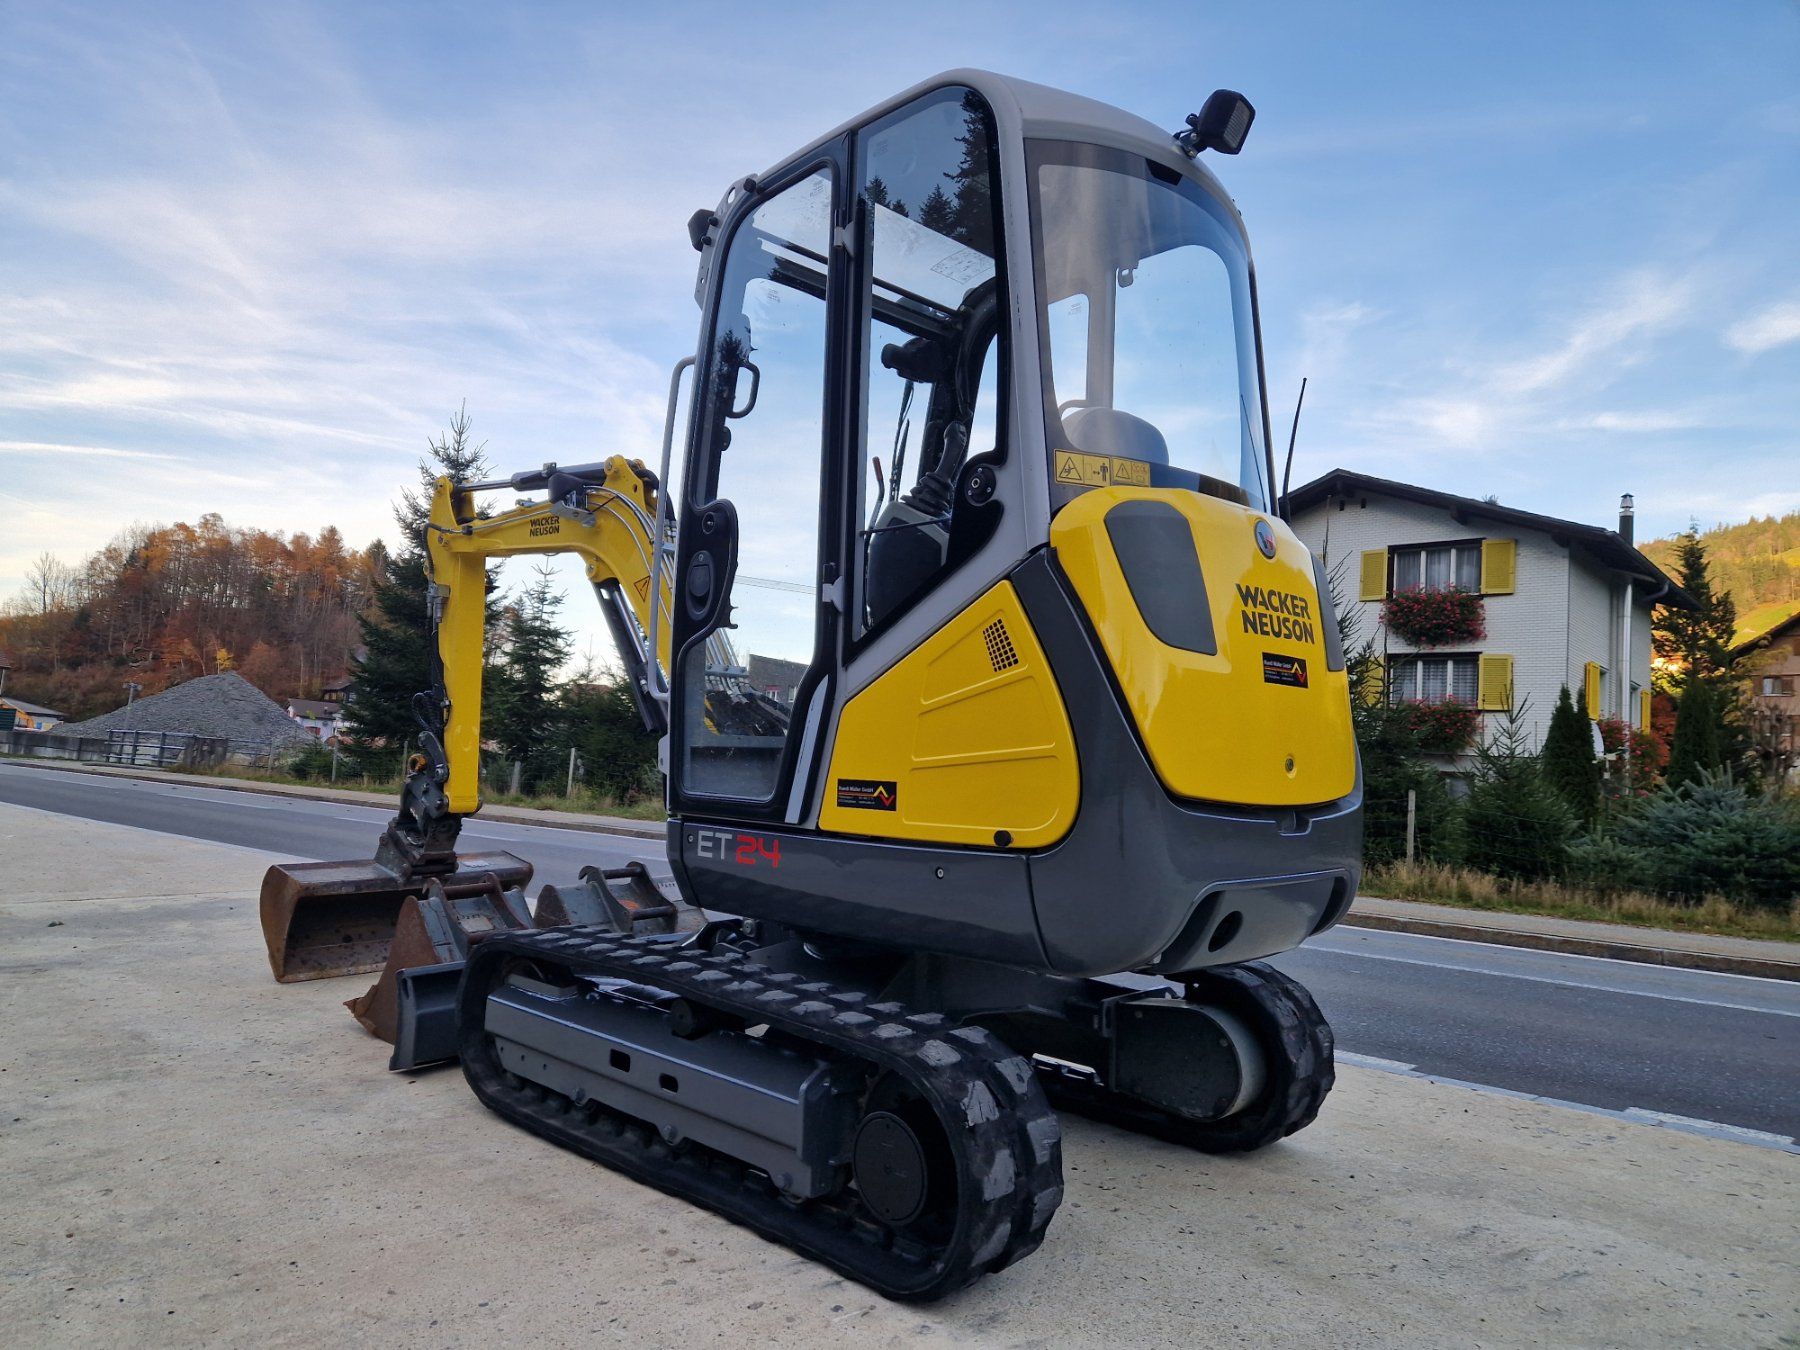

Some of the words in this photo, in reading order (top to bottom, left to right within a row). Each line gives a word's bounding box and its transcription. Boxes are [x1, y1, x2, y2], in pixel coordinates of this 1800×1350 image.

[529, 515, 560, 528] WACKER
[529, 525, 560, 537] NEUSON
[1235, 583, 1312, 620] WACKER
[1241, 609, 1315, 645] NEUSON
